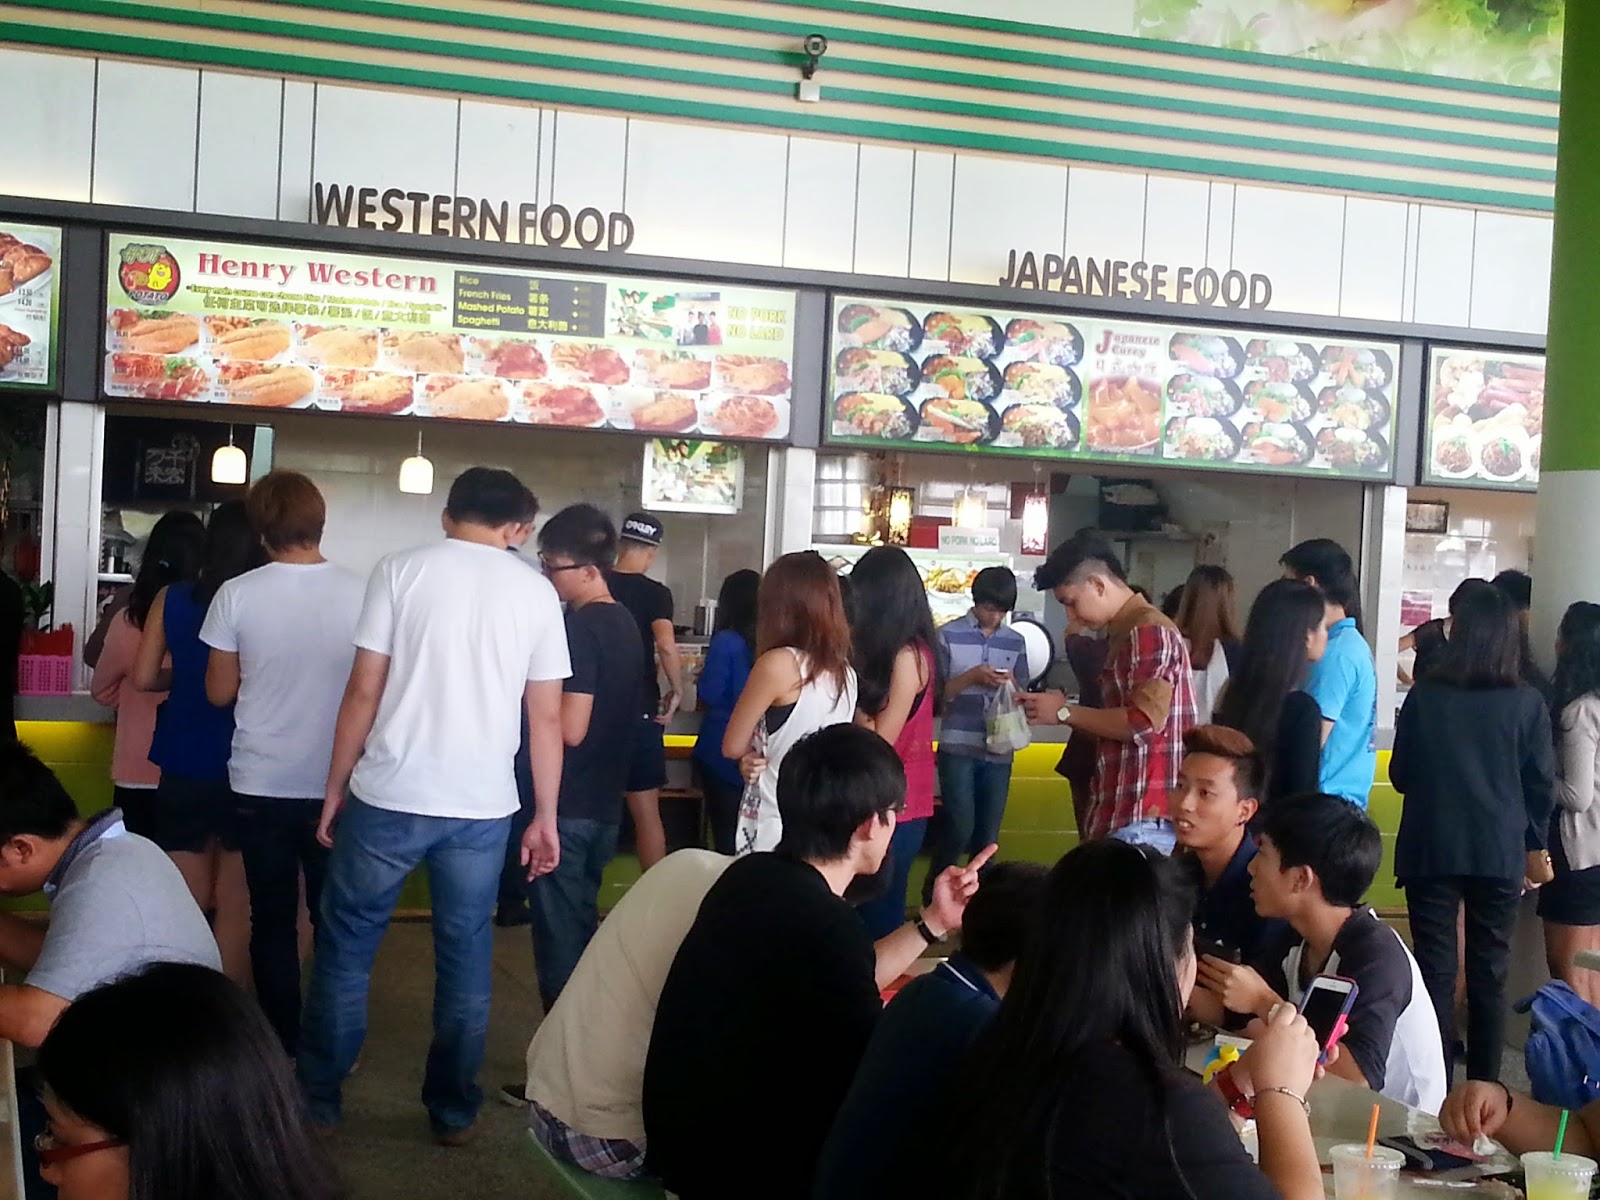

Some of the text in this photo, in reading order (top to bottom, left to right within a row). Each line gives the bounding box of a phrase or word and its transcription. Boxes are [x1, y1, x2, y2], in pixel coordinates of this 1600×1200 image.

[314, 181, 635, 253] WESTERN FOOD
[198, 252, 437, 292] Henry Western
[1000, 249, 1272, 311] JAPANESE FOOD
[459, 275, 480, 286] Rice
[128, 291, 169, 302] POTATO
[459, 289, 512, 301] French Fries
[458, 302, 525, 315] Mashed Potato
[729, 307, 787, 324] NO PORK
[457, 314, 500, 327] Spaghetti
[727, 325, 784, 341] NO LARD
[625, 520, 657, 536] OAKLEY
